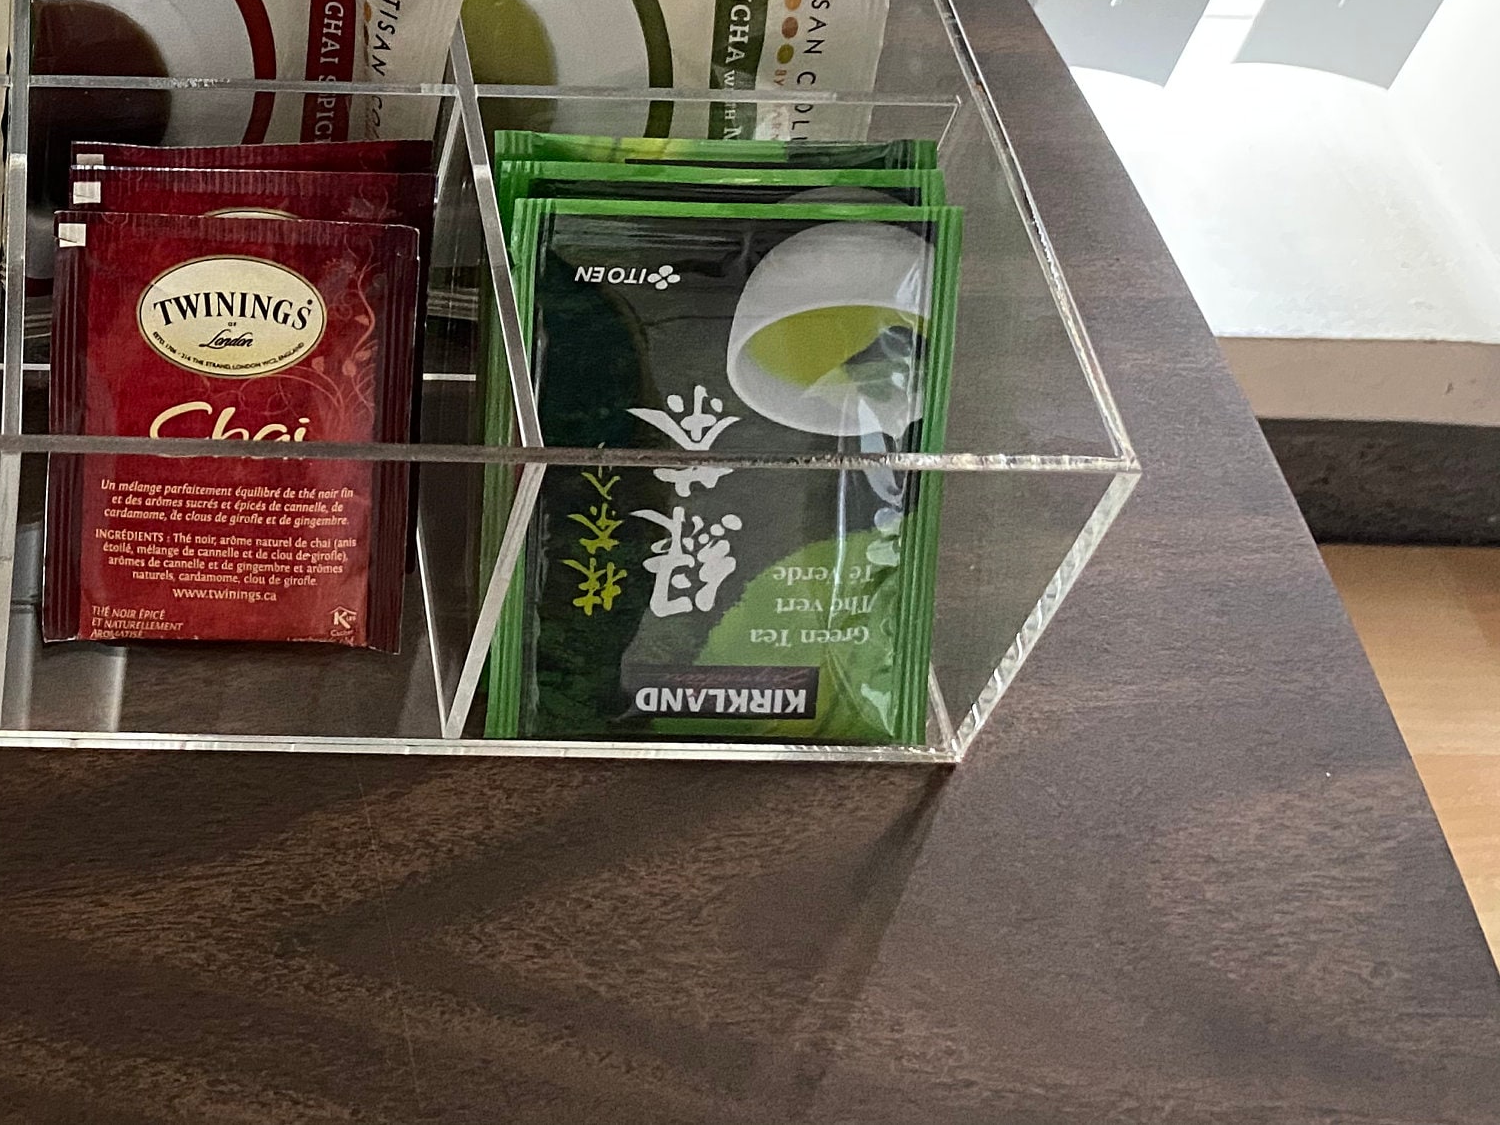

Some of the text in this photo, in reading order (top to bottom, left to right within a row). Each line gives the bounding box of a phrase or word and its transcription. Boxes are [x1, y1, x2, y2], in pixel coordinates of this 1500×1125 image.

[320, 1, 343, 64] CHAI
[153, 292, 313, 330] TWININGS
[199, 329, 252, 349] London
[101, 480, 353, 499] Un mélange parfaitement équilibré de thé noir fin
[173, 588, 276, 603] www.twinings.ca
[776, 597, 823, 613] vert
[91, 605, 165, 620] THÉ NOIR ÉPICÉ
[750, 626, 869, 647] Green Tea
[636, 687, 806, 713] KIRKLAND
